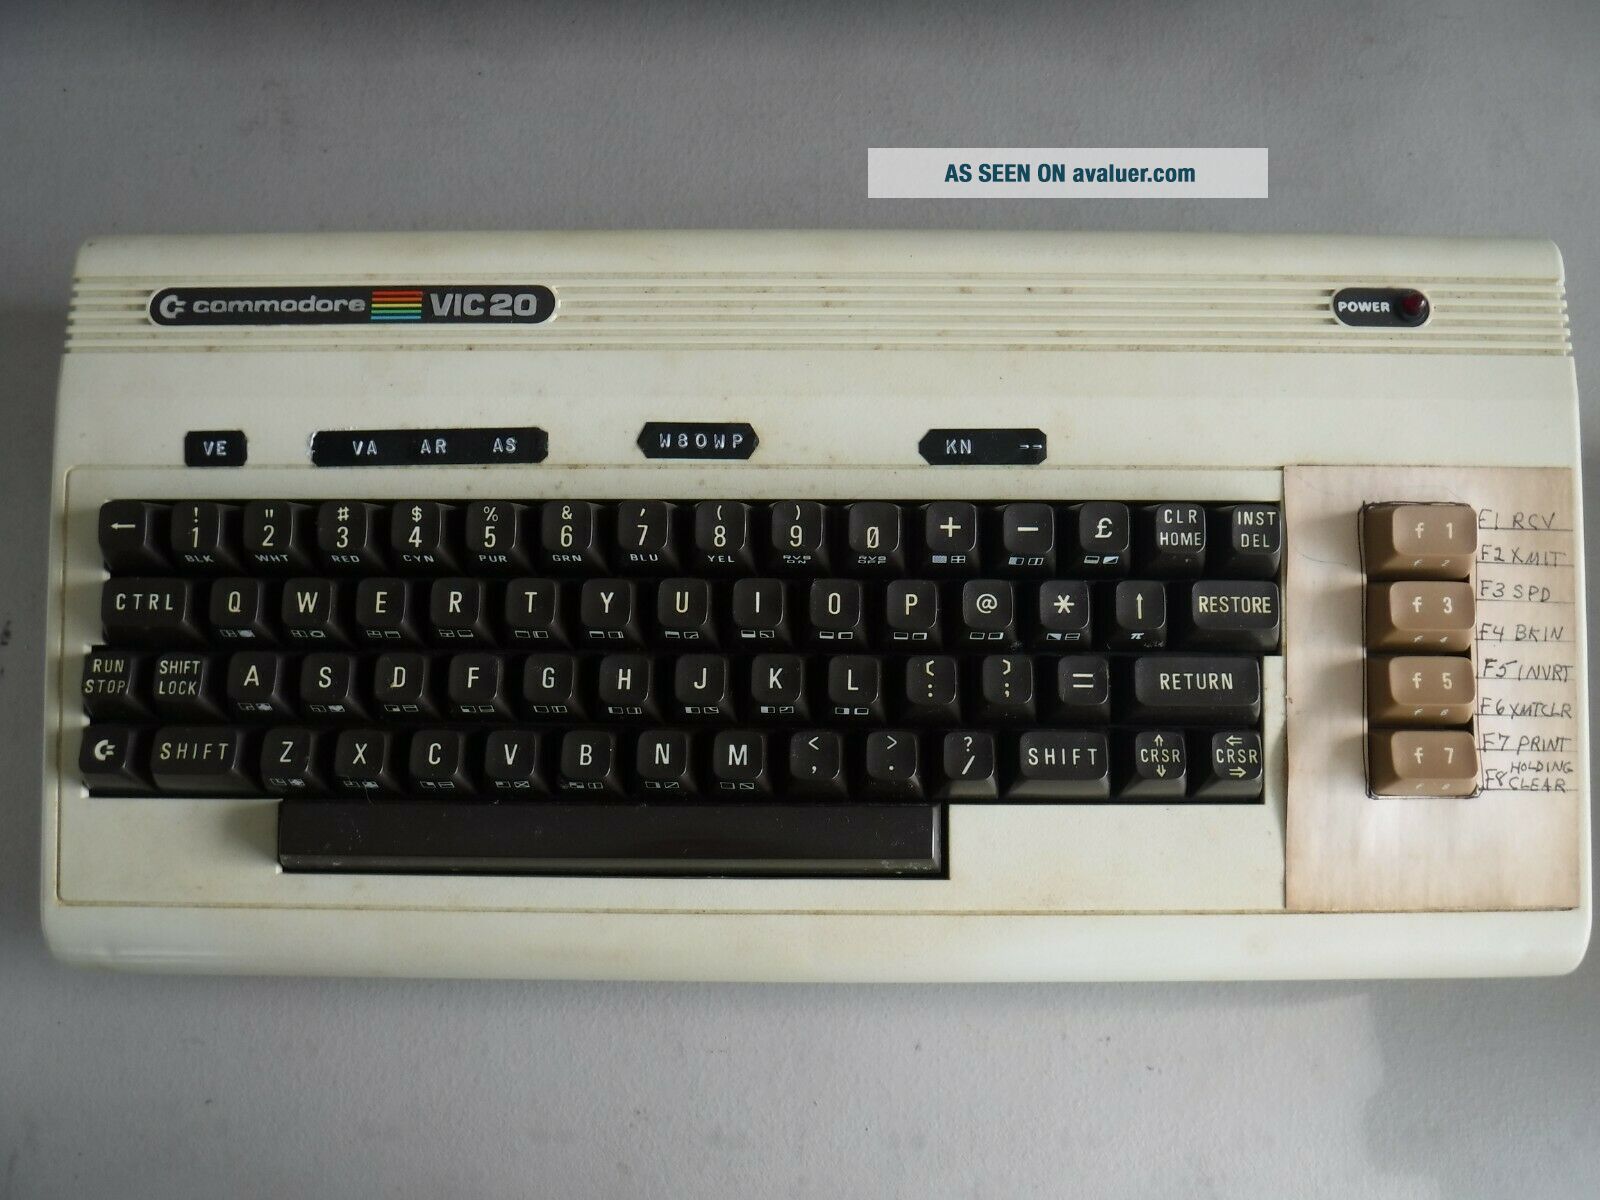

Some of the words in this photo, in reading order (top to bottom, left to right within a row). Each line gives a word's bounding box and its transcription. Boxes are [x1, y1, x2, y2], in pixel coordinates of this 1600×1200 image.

[193, 294, 366, 314] commodore
[430, 292, 485, 317] VIC
[490, 293, 538, 317] 20
[1338, 302, 1389, 312] POWER
[204, 441, 226, 455] VE
[353, 441, 377, 455] VA
[421, 439, 446, 453] AR
[493, 438, 515, 452] AS
[947, 440, 971, 454] KN
[338, 507, 349, 521] #
[412, 506, 421, 522] $
[484, 507, 498, 521] %
[562, 506, 572, 519] &
[1165, 509, 1196, 523] CLR
[1238, 511, 1275, 525] INST
[1512, 512, 1555, 530] RCV
[193, 527, 198, 547] 1
[263, 525, 274, 546] 2
[337, 528, 348, 547] 3
[409, 526, 422, 547] 4
[485, 526, 495, 547] 5
[561, 525, 572, 547] 6
[638, 525, 648, 545] 7
[714, 526, 726, 547] 8
[790, 526, 802, 546] 9
[1095, 518, 1112, 538] £
[1160, 532, 1200, 545] HOME
[1241, 534, 1269, 547] DEL
[1481, 544, 1505, 562] F2
[1511, 547, 1566, 567] XMIT
[229, 591, 240, 612] Q
[1480, 580, 1505, 597] F3
[1513, 584, 1551, 603] SPD
[116, 594, 173, 610] CTRL
[298, 592, 317, 612] W
[376, 592, 387, 612] E
[450, 592, 462, 612] R
[525, 592, 537, 612] T
[601, 592, 614, 613] Y
[676, 592, 688, 612] U
[906, 594, 917, 615] P
[977, 594, 997, 613] @
[1199, 596, 1271, 613] RESTORE
[1479, 622, 1504, 641] F4
[1514, 624, 1563, 642] BKIN
[93, 659, 123, 672] RUN
[160, 660, 200, 674] SHIFT
[244, 665, 259, 685] A
[1483, 658, 1518, 678] F5
[85, 679, 127, 694] STOP
[319, 667, 331, 687] S
[391, 667, 405, 687] D
[468, 667, 479, 688] F
[543, 668, 554, 688] G
[618, 669, 631, 689] H
[694, 668, 706, 689] J
[770, 668, 782, 688] K
[848, 670, 858, 690] L
[1160, 673, 1232, 689] RETURN
[159, 681, 196, 694] LOCK
[1480, 697, 1505, 716] F6
[161, 743, 228, 759] SHIFT
[280, 742, 293, 762] Z
[429, 743, 441, 764] C
[1482, 732, 1510, 753] F7
[1517, 735, 1571, 755] PRINT
[353, 744, 367, 764] X
[505, 744, 517, 765] V
[580, 745, 591, 765] B
[656, 744, 669, 764] N
[729, 745, 747, 765] M
[1029, 748, 1096, 765] SHIFT
[1141, 749, 1180, 762] CRSR
[1216, 749, 1257, 763] CRSR
[1510, 760, 1573, 774] HOLDING
[1508, 777, 1566, 792] CLEAR
